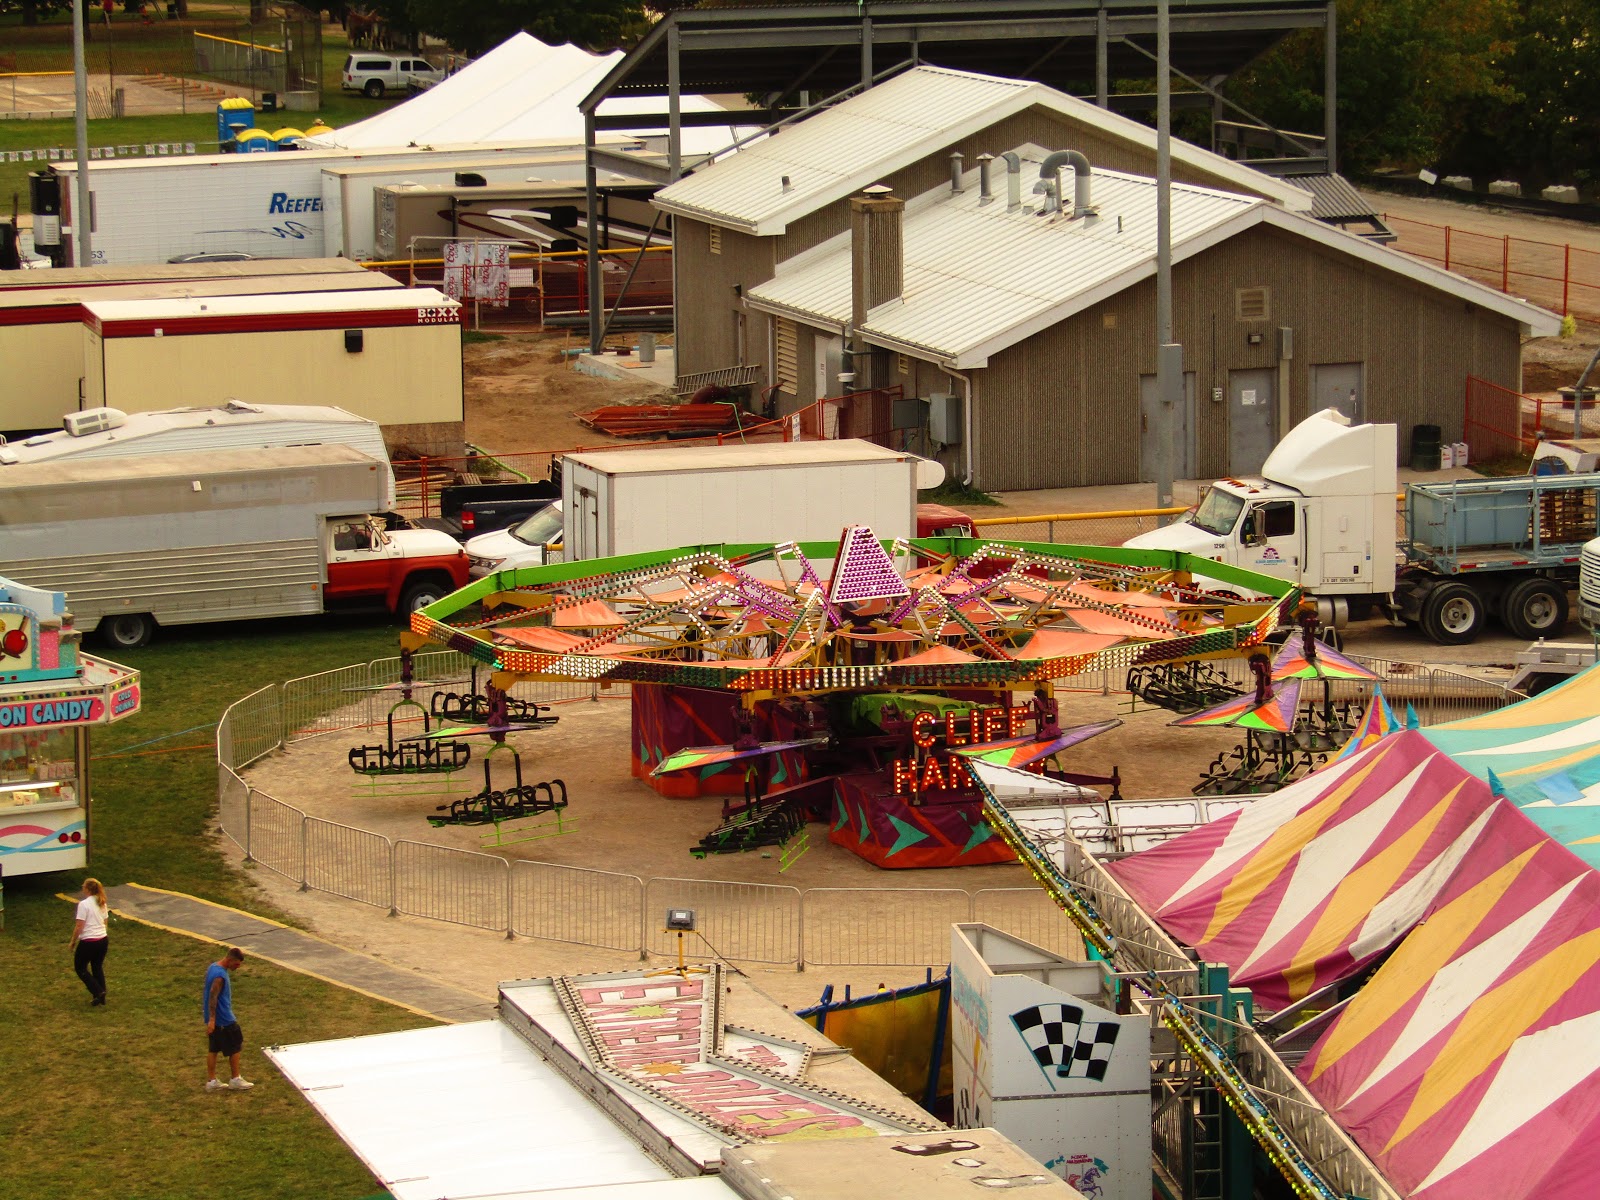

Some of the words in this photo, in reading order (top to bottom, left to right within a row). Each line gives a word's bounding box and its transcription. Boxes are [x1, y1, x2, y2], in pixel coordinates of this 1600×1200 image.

[32, 699, 94, 724] CANDY
[115, 699, 135, 715] DRINKS
[117, 690, 132, 702] COLD
[912, 706, 1030, 747] CLIFF
[578, 979, 704, 1072] EXTREME
[640, 1069, 865, 1138] PRIZES
